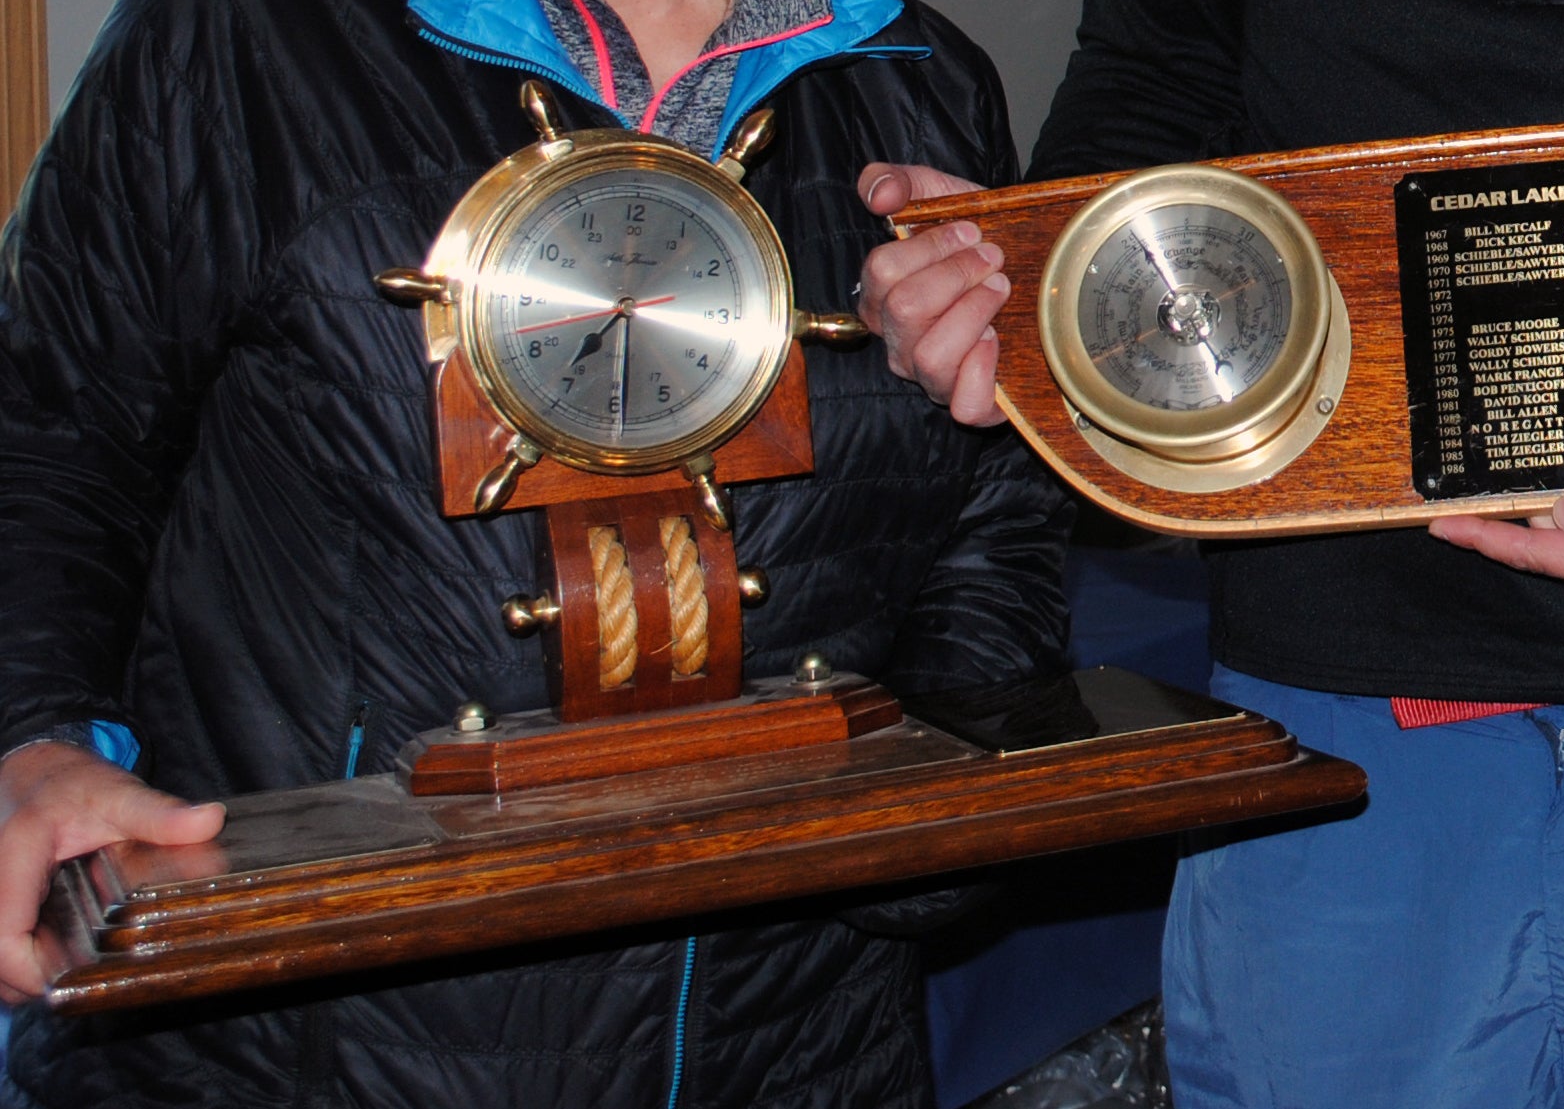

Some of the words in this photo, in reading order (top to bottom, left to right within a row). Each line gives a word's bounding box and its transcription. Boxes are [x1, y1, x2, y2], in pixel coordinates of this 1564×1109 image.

[1430, 190, 1508, 211] CEDAR
[581, 213, 595, 229] 11
[627, 204, 645, 221] 12
[1424, 229, 1447, 240] 1967
[1463, 225, 1492, 237] BILL
[1493, 219, 1552, 234] METCALF
[1425, 241, 1448, 252] 1968
[1475, 236, 1506, 248] DICK
[1507, 232, 1542, 245] KECK
[539, 244, 559, 261] 10
[1426, 253, 1449, 265] 1969
[1454, 242, 1564, 262] SCHIEBLE/SAWYER
[561, 258, 575, 268] 22
[708, 259, 720, 276] 2
[1427, 265, 1450, 276] 1970
[1427, 277, 1449, 289] 1971
[1429, 289, 1451, 301] 1972
[1430, 301, 1452, 313] 1973
[717, 308, 729, 324] 3
[1431, 314, 1453, 325] 1974
[1432, 326, 1454, 338] 1975
[1471, 321, 1512, 334] BRUCE
[1514, 317, 1559, 330] MOORE
[528, 341, 541, 358] 8
[1432, 338, 1455, 350] 1976
[1466, 334, 1508, 347] WALLY
[697, 354, 709, 370] 4
[1433, 351, 1456, 362] 1977
[1468, 346, 1512, 359] GORDY
[1434, 363, 1457, 375] 1978
[1468, 358, 1510, 372] WALLY
[1435, 375, 1458, 387] 1979
[1475, 371, 1512, 384] MARK
[1514, 366, 1563, 380] PRANGE
[562, 377, 574, 394] 7
[659, 386, 670, 402] 5
[1436, 388, 1459, 399] 1980
[1473, 384, 1498, 396] BOB
[1437, 400, 1458, 412] 1981
[1483, 395, 1521, 408] DAVID
[1522, 392, 1559, 404] KOCH
[1486, 408, 1515, 420] BILL
[1516, 404, 1558, 418] ALLEN
[1438, 425, 1461, 437] 1983
[1439, 438, 1462, 449] 1984
[1484, 433, 1508, 445] TIM
[1510, 429, 1564, 443] ZIEGLER
[1440, 450, 1463, 462] 1985
[1484, 446, 1509, 458] TIM
[1511, 441, 1564, 456] ZIEGLER
[1441, 463, 1465, 475] 1986
[1488, 459, 1512, 470] JOE
[1514, 454, 1563, 468] SCHAUB
